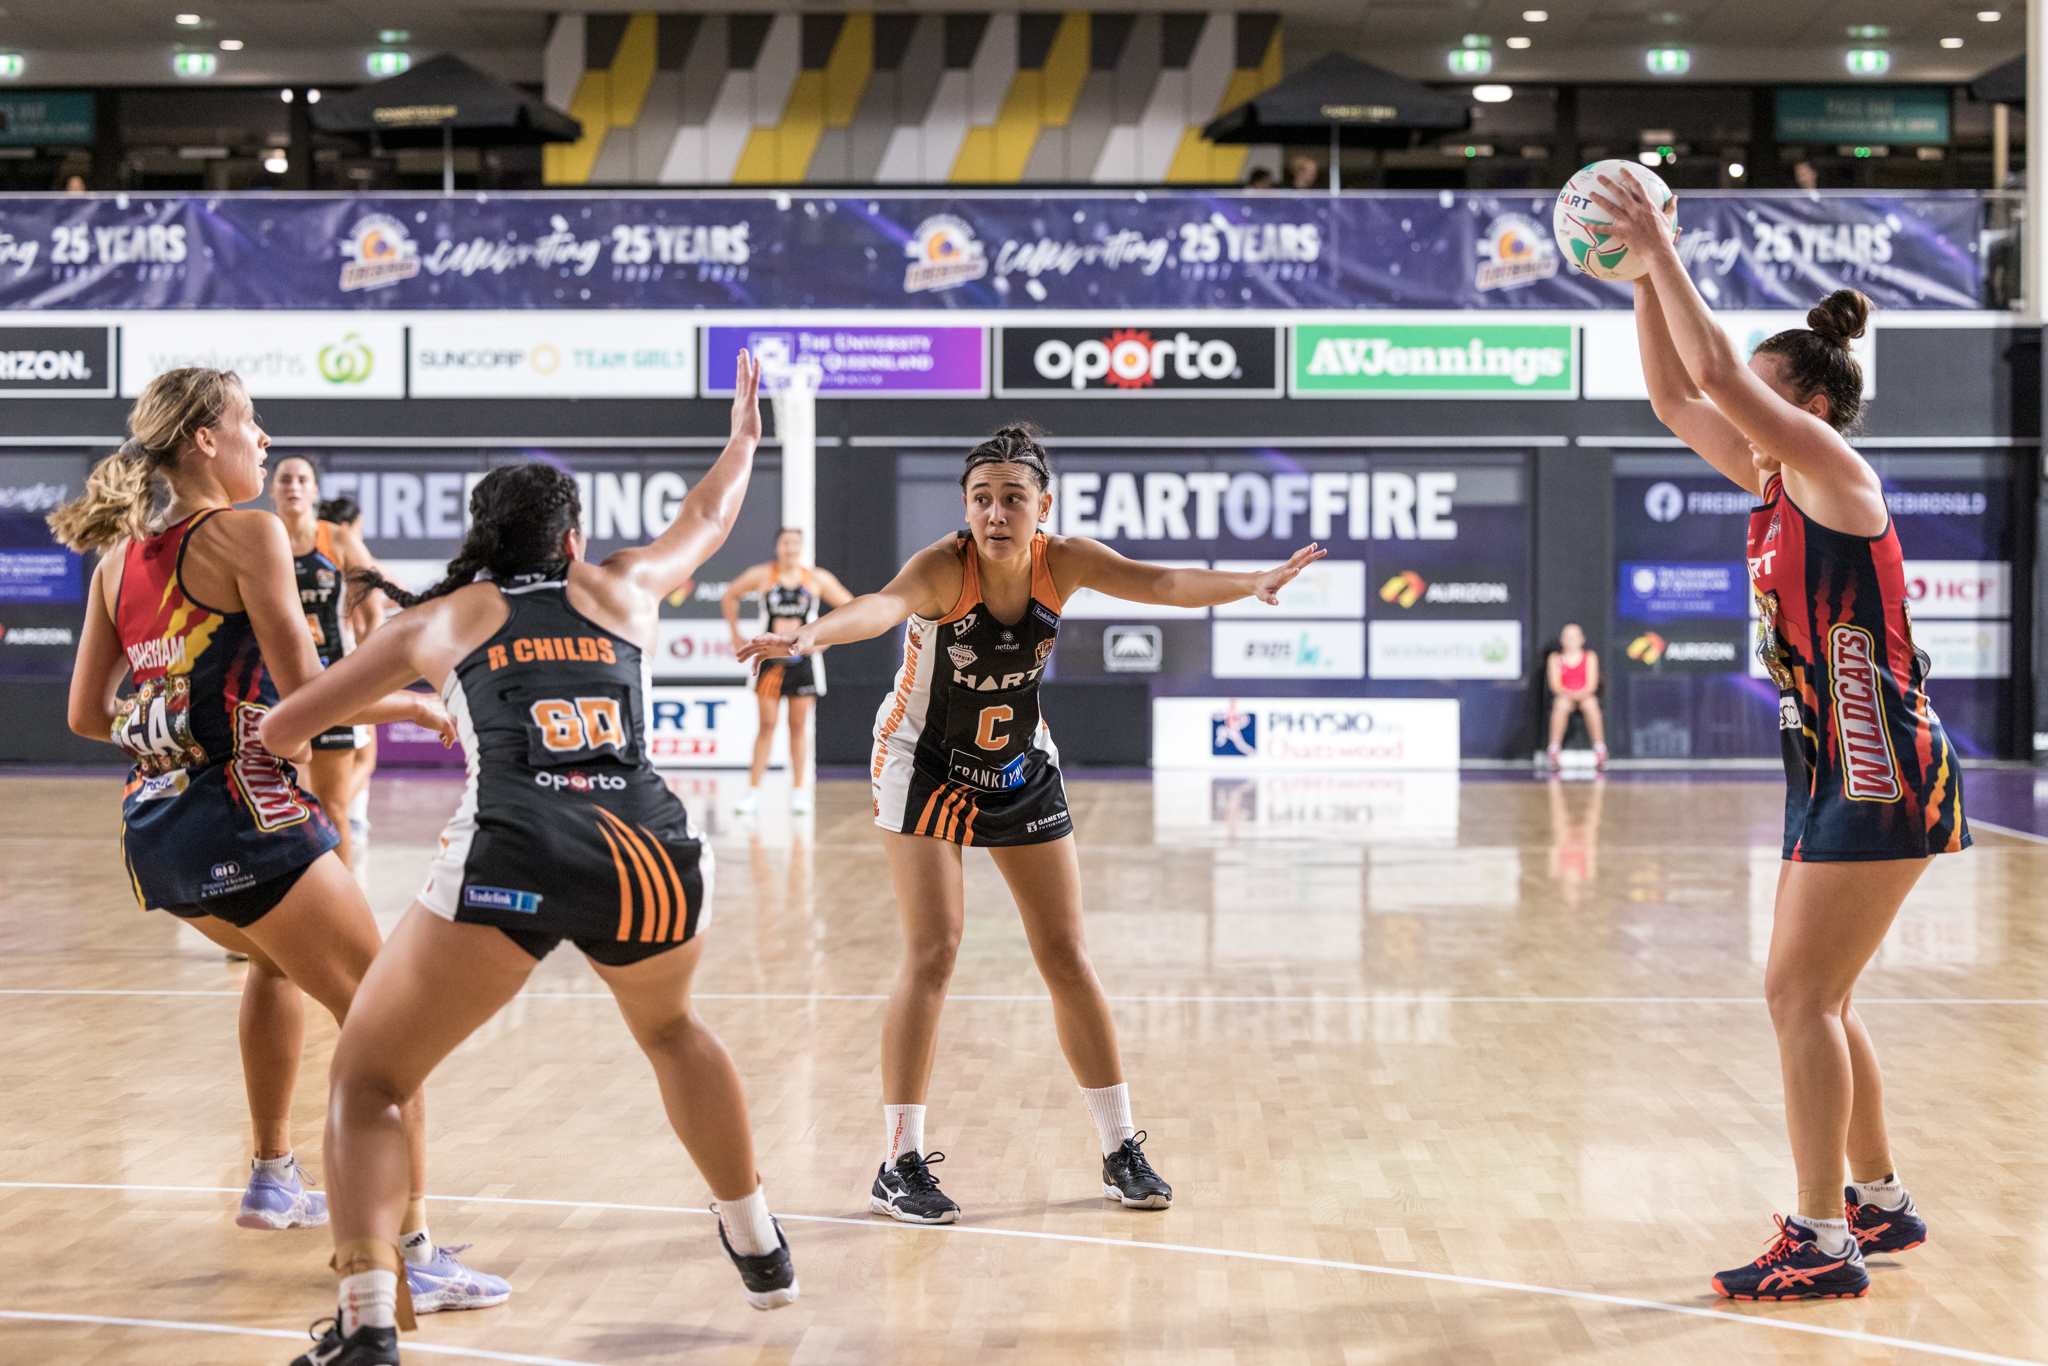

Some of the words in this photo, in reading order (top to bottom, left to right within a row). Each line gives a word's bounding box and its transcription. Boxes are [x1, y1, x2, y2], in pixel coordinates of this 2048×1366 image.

[51, 224, 90, 264] 25
[94, 224, 188, 264] YEARS
[611, 224, 651, 264] 25
[655, 224, 750, 264] YEARS
[1179, 222, 1221, 263] 25
[1222, 222, 1320, 263] YEARS
[1754, 222, 1794, 263] 25
[1799, 222, 1894, 265] YEARS
[419, 348, 526, 371] SUNCORP
[1034, 332, 1237, 389] oporto
[1306, 337, 1567, 386] AVJennings
[1046, 472, 1457, 540] EARTOFFIRE
[1748, 549, 1776, 581] RT
[488, 645, 509, 671] R
[513, 637, 617, 665] CHILDS
[995, 643, 1019, 651] netball
[953, 665, 1044, 691] HART
[652, 701, 727, 730] RT
[975, 704, 1014, 751] C
[1838, 632, 1894, 794] WILDCATS
[535, 771, 627, 791] oporto
[890, 1112, 905, 1160] TIGERS
